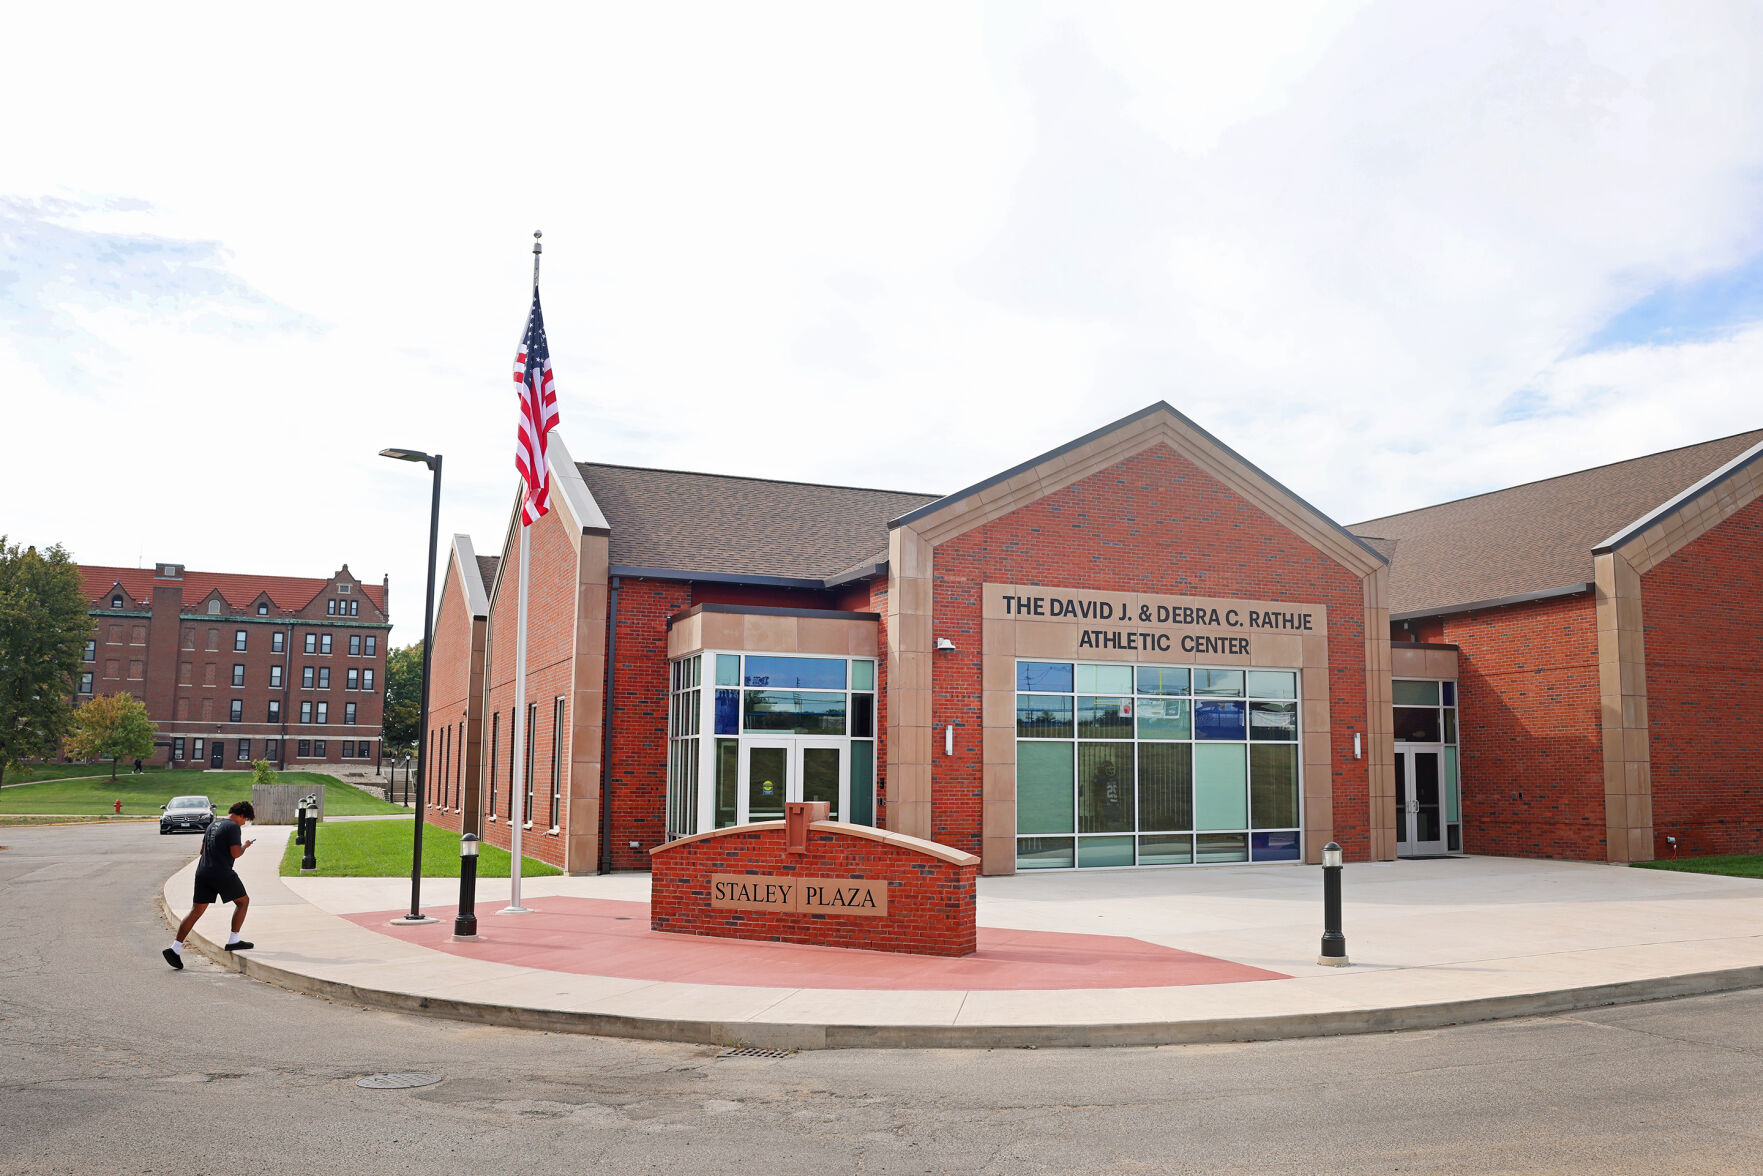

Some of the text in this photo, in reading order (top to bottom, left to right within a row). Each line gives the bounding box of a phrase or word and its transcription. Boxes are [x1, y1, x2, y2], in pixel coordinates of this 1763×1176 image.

[1002, 595, 1313, 631] THE DAVID J. & DEBRA C. RATHJE
[1079, 630, 1250, 655] ATHLETIC CENTER
[715, 881, 877, 908] STALEY PLAZA
